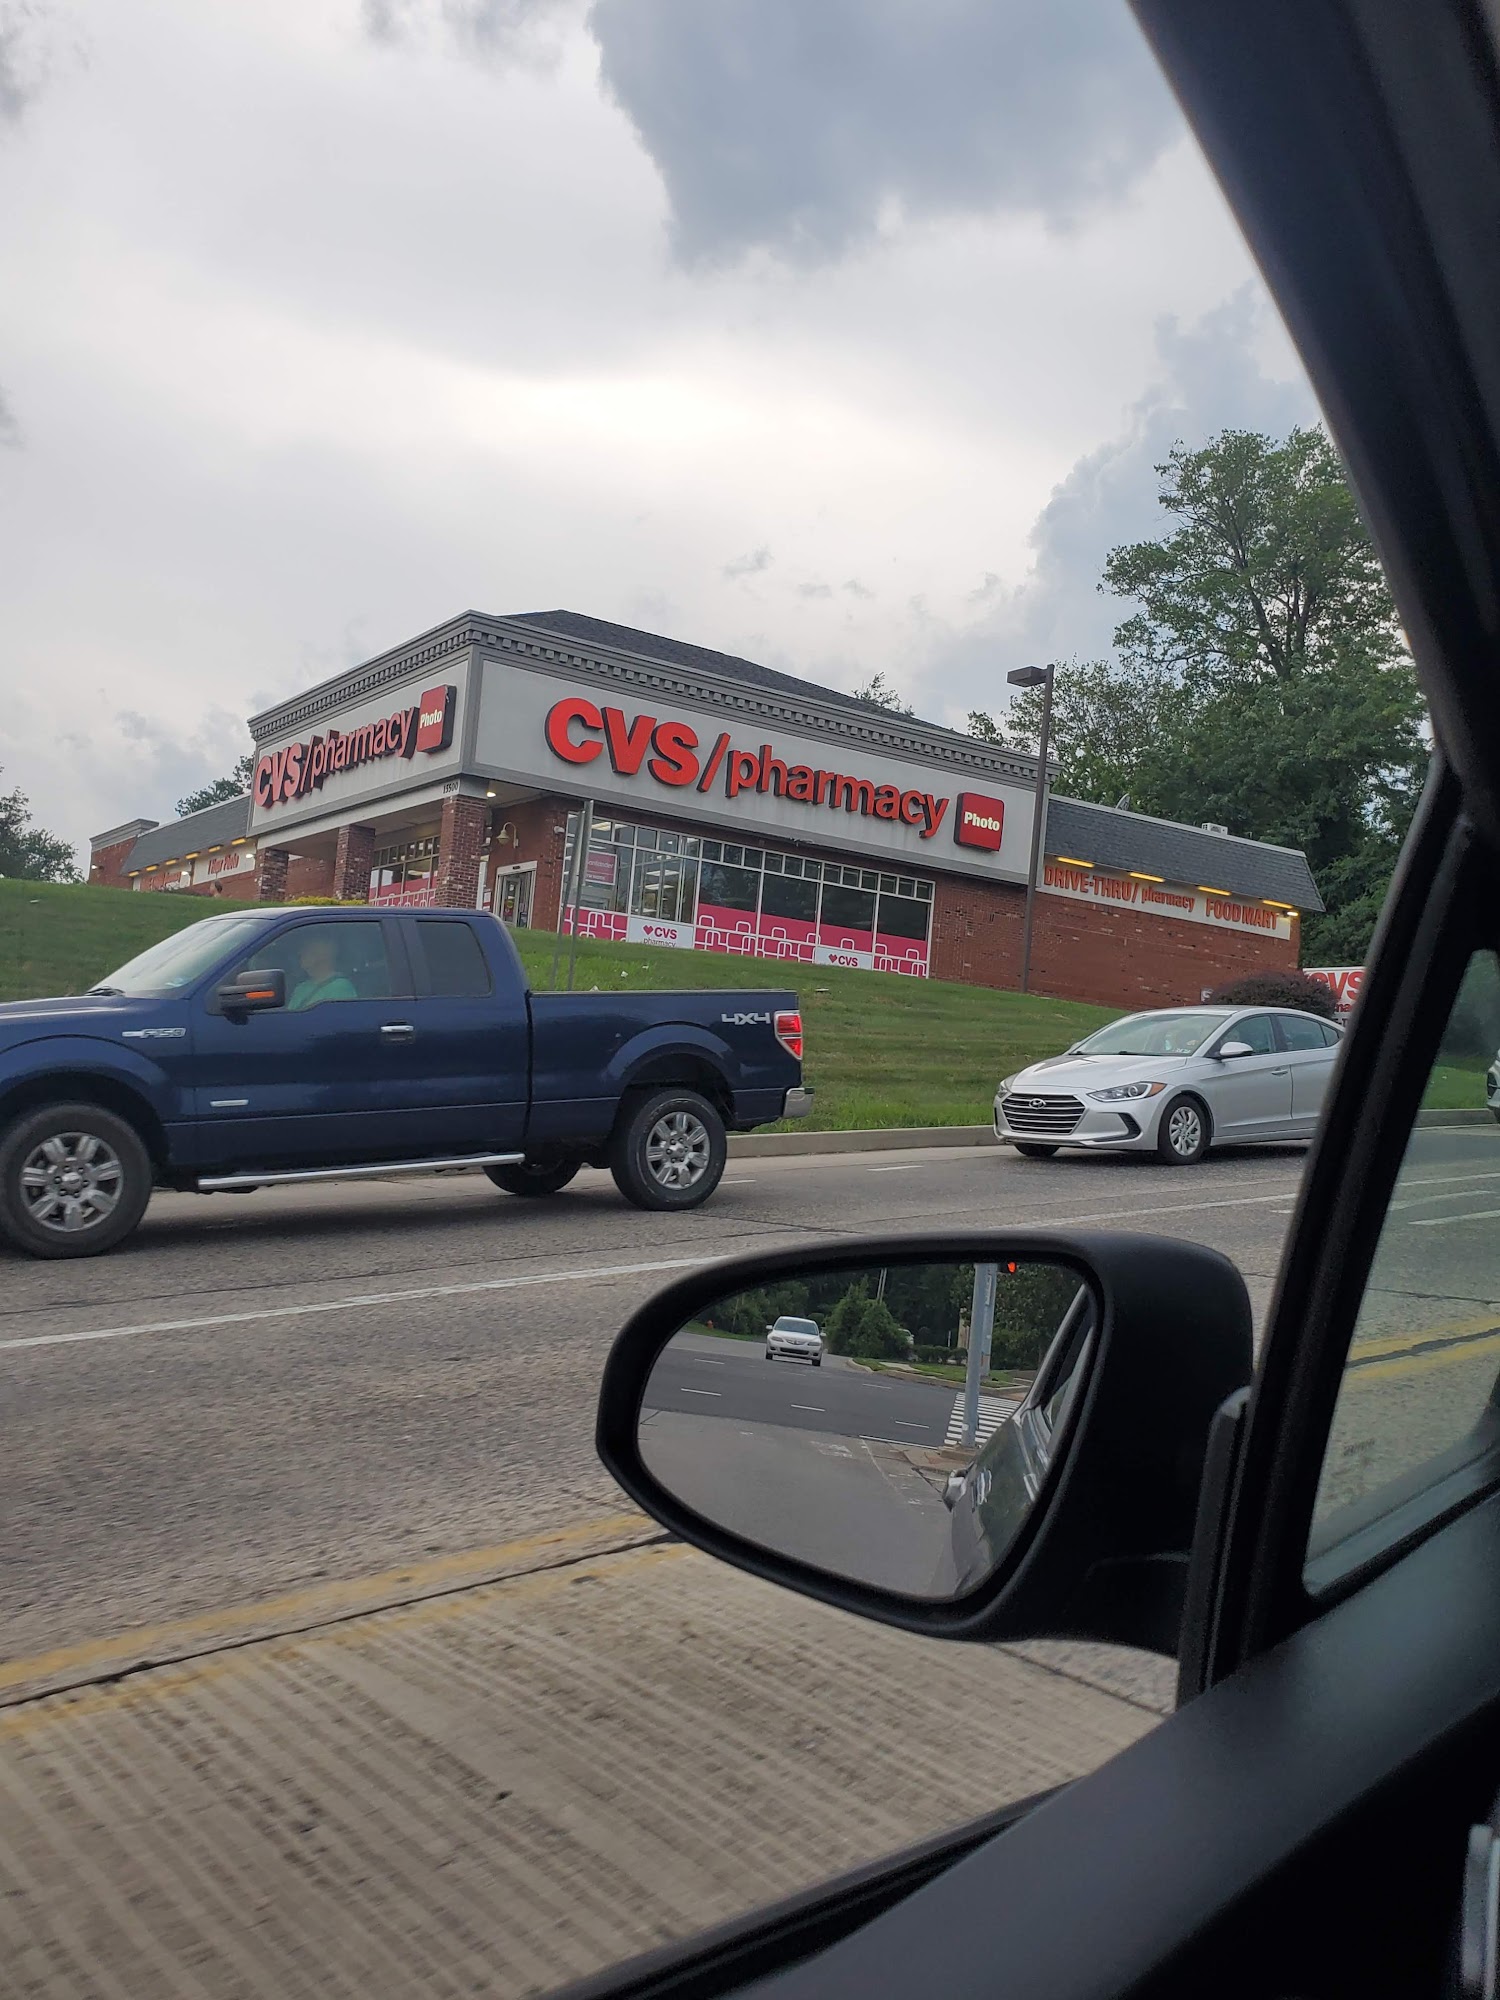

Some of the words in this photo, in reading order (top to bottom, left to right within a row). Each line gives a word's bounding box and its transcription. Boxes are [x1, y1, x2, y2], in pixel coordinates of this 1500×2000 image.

[420, 708, 443, 729] Photo
[964, 811, 1000, 832] Photo
[1142, 887, 1196, 912] pharmacy
[654, 926, 677, 940] CVS
[838, 955, 858, 967] CVS
